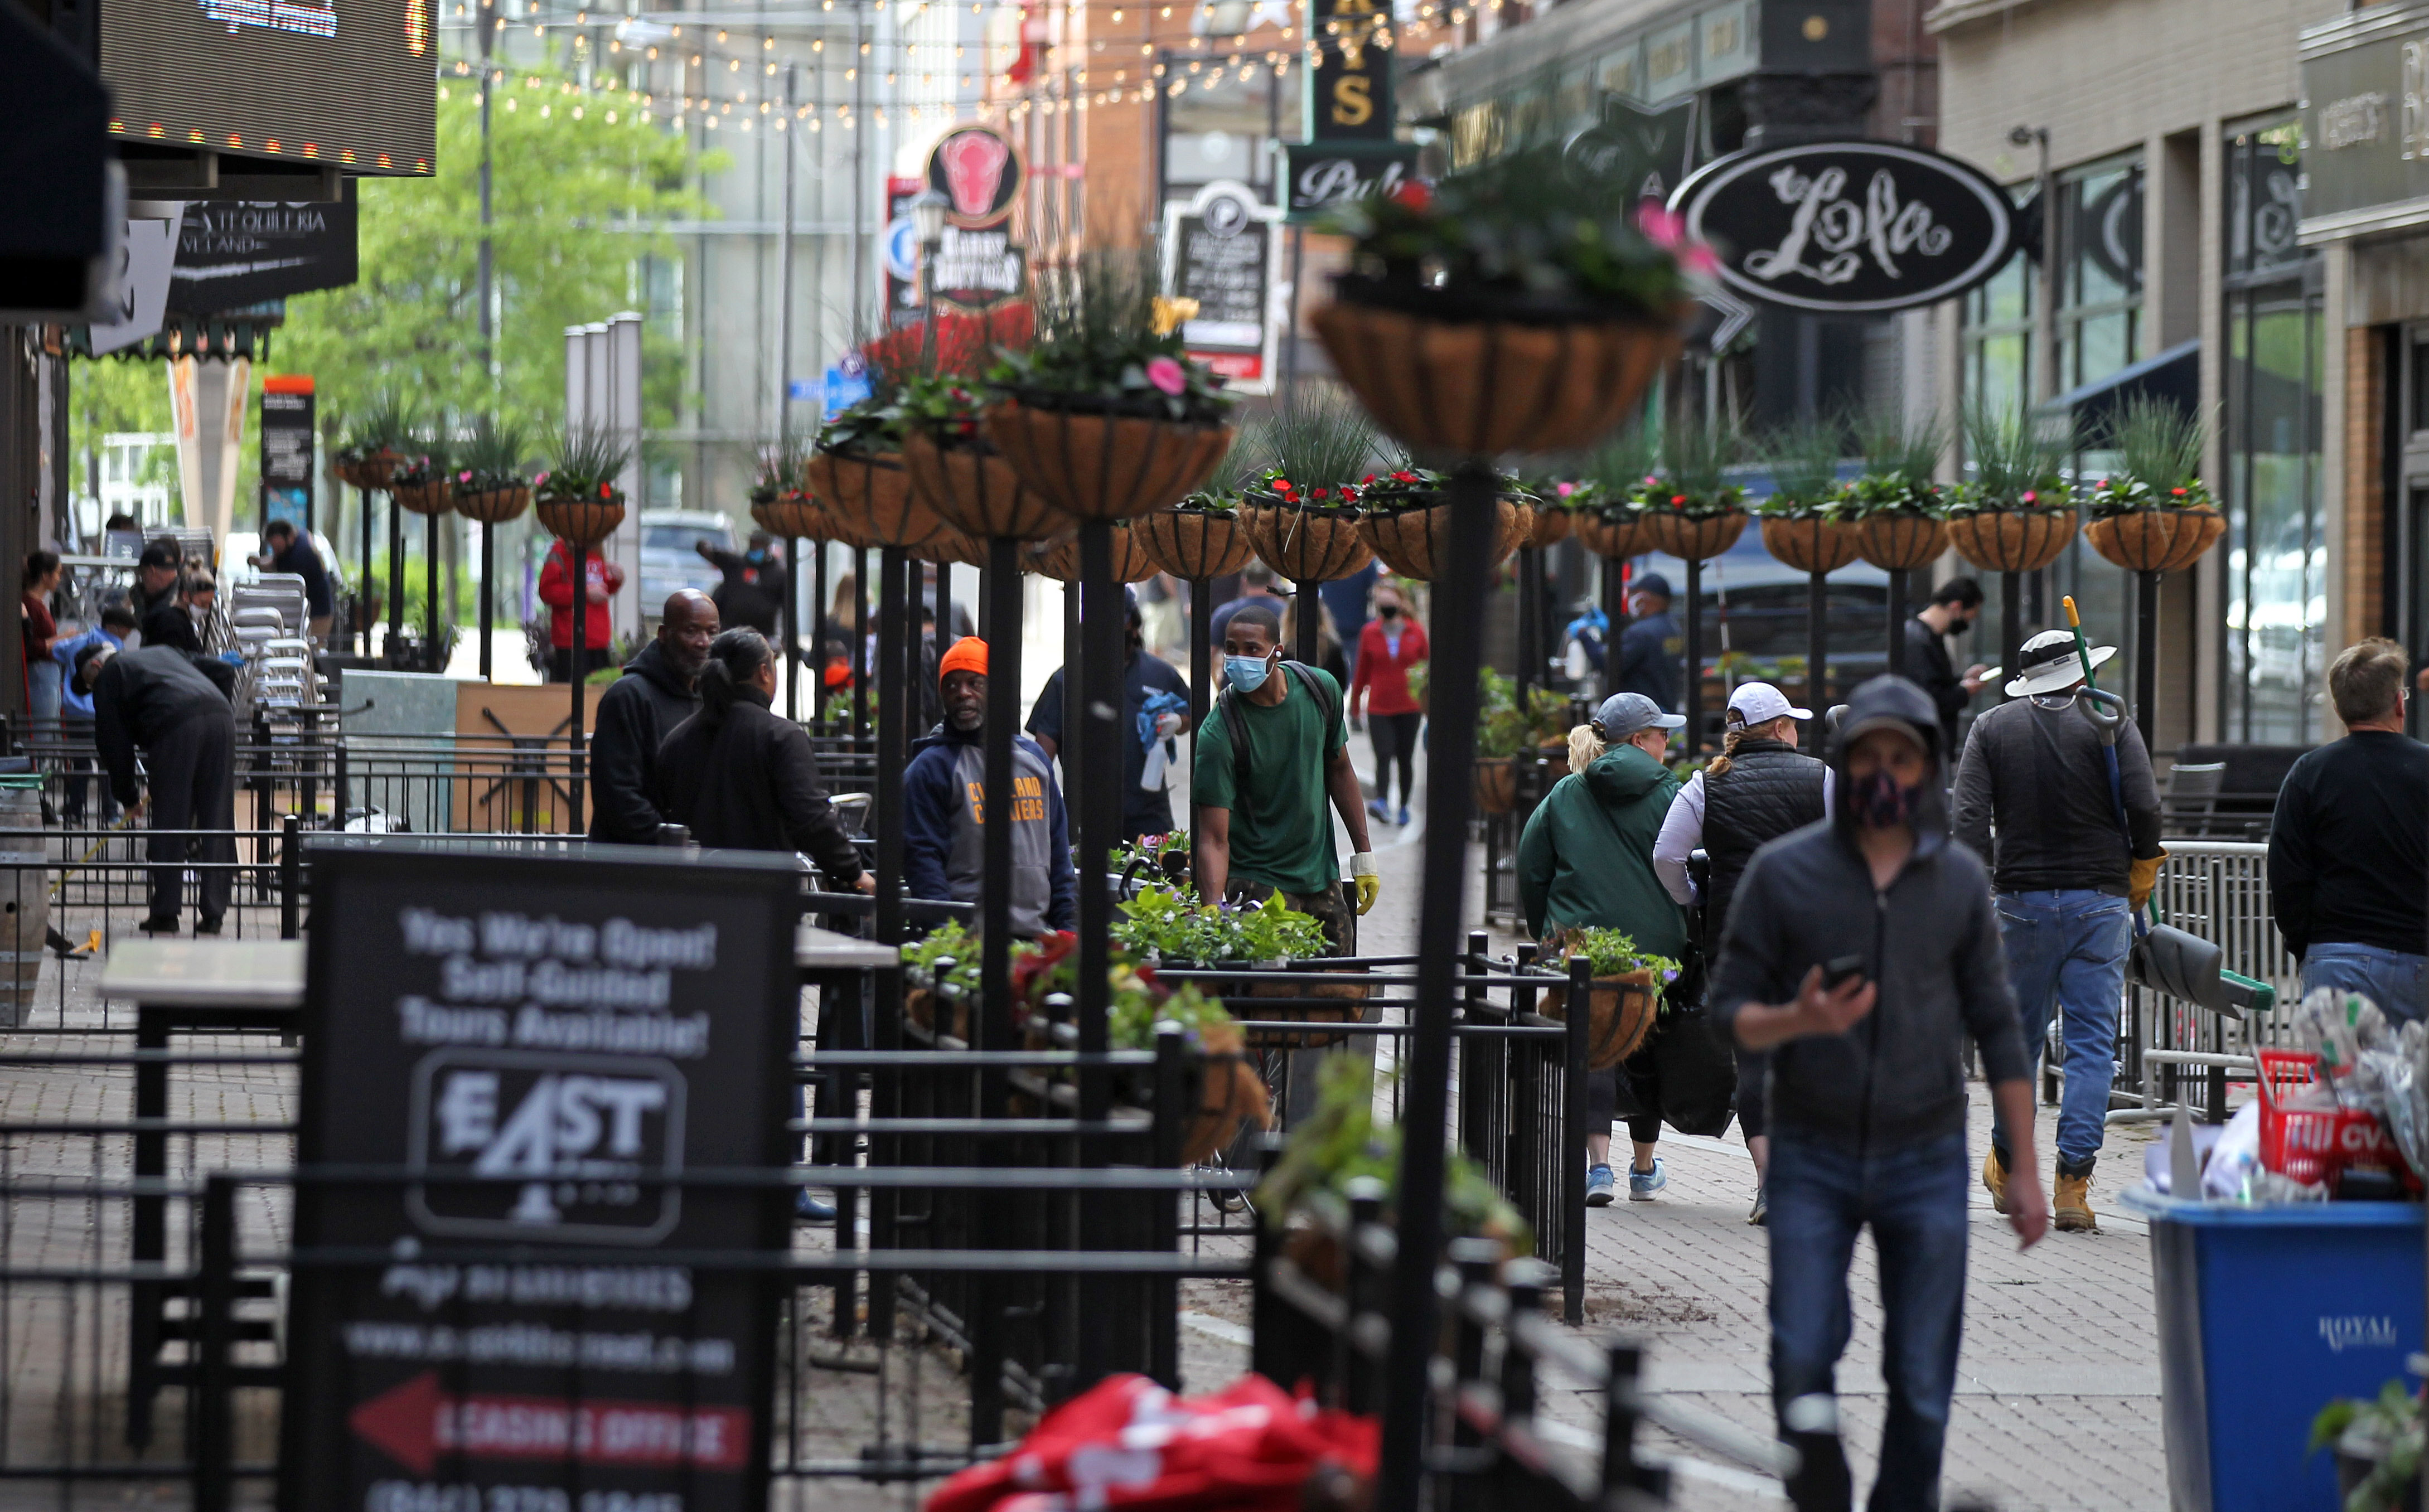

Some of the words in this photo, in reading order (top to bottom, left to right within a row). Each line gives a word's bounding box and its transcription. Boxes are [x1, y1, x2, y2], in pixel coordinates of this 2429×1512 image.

[1743, 164, 1953, 285] Lola
[400, 907, 475, 954] Yes
[480, 911, 596, 959] We're
[601, 917, 718, 970] Open!
[398, 996, 507, 1046] Tours
[514, 1005, 710, 1057] Available!
[439, 1069, 667, 1177] EAST
[2319, 1315, 2396, 1351] ROYAL
[434, 1400, 594, 1451] LEASING
